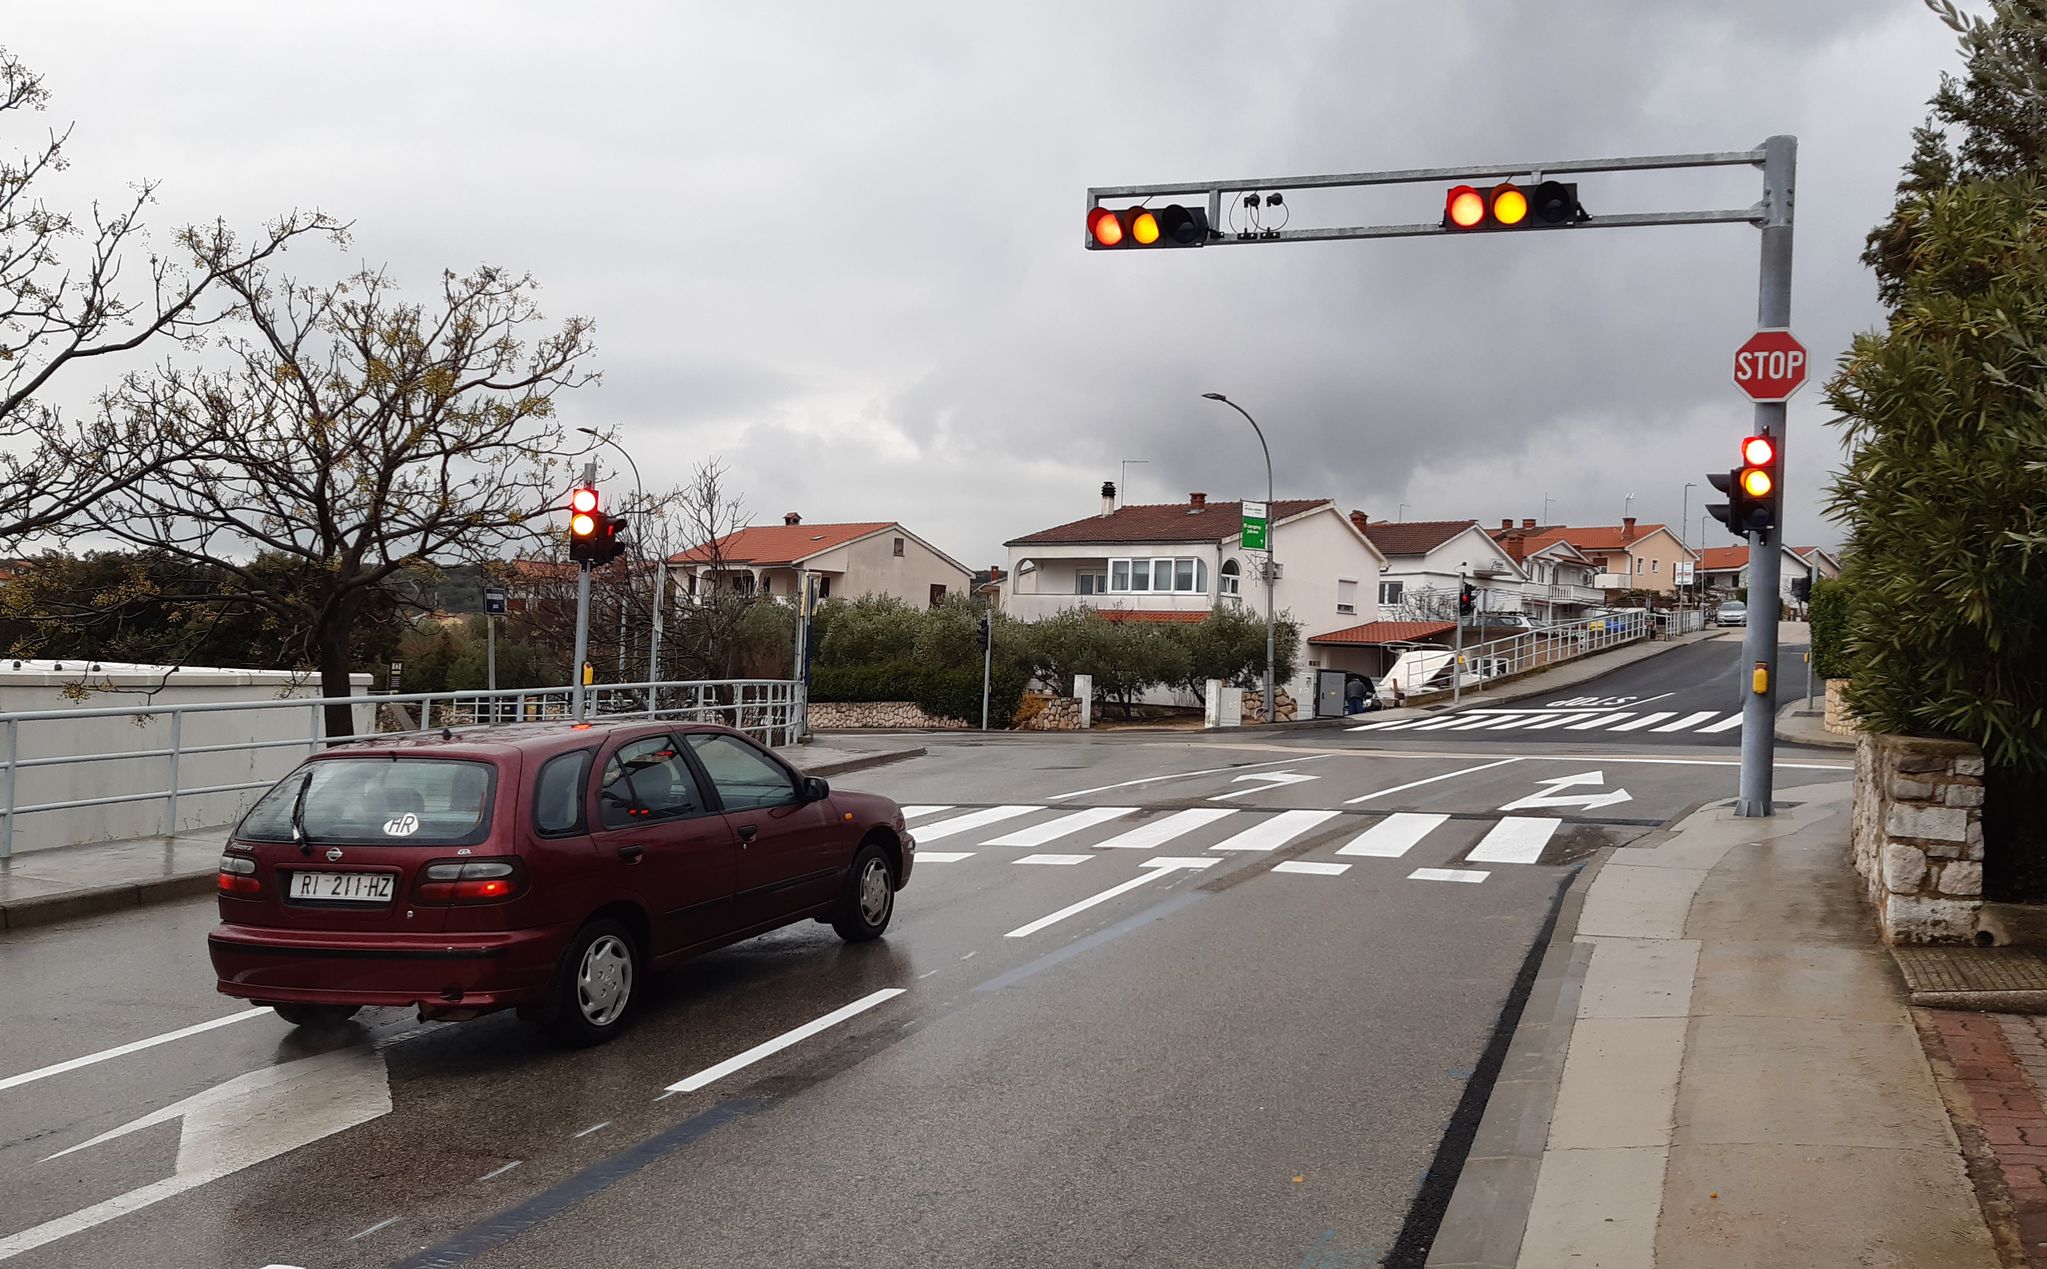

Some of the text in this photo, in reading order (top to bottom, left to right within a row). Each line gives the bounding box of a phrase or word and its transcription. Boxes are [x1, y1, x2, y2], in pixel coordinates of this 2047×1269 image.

[1737, 350, 1804, 380] STOP
[388, 816, 415, 833] HR
[301, 875, 391, 897] RI 211-HZ
